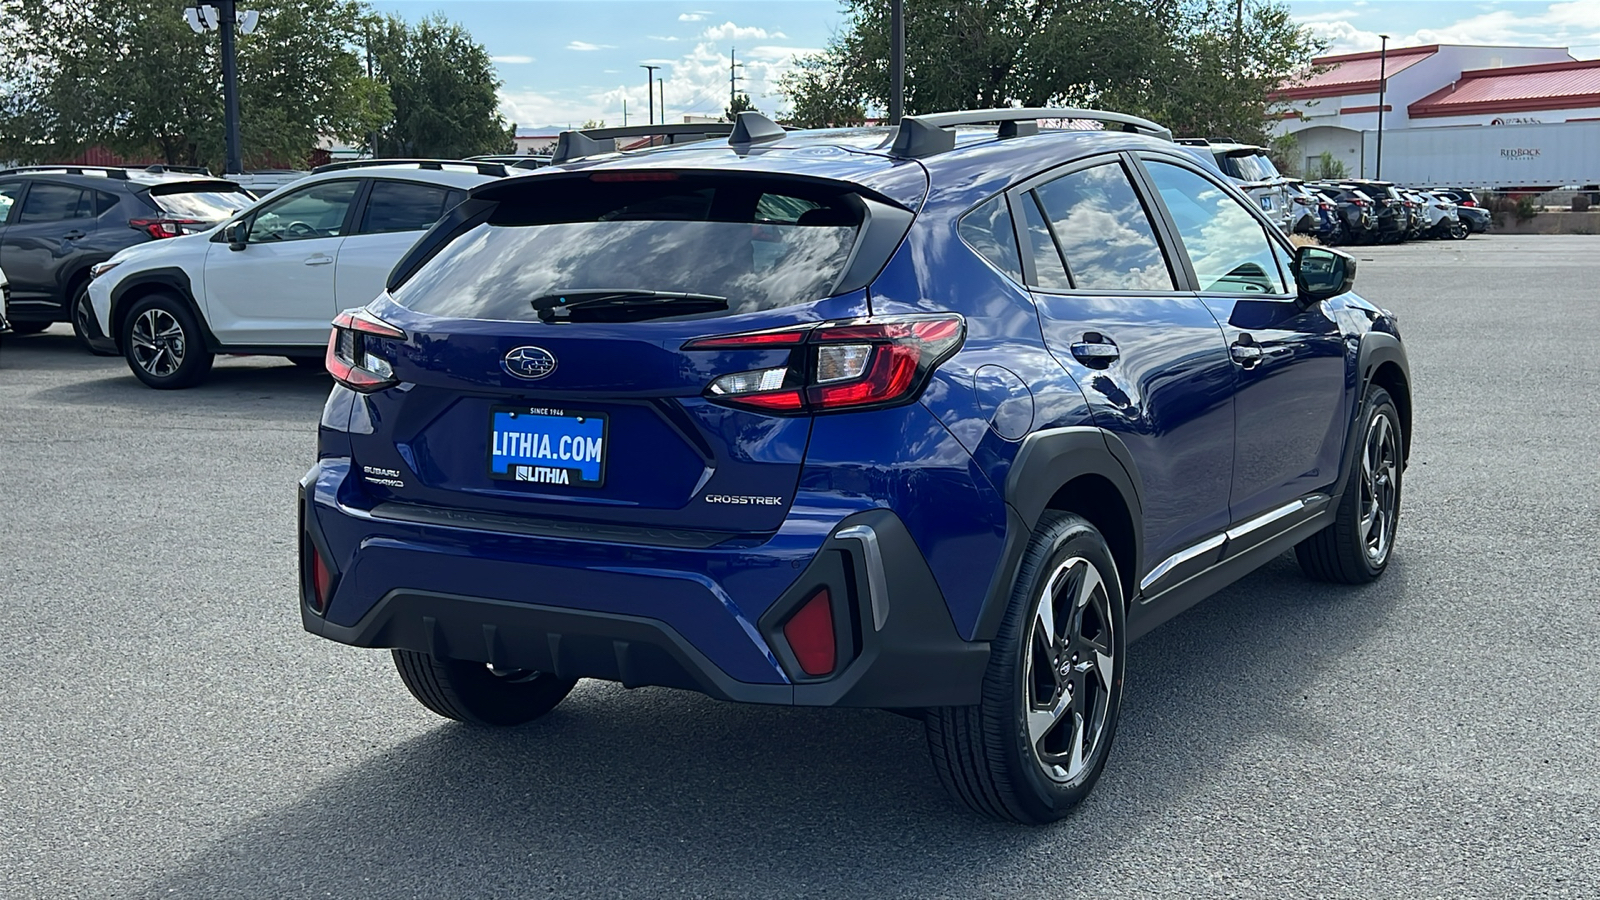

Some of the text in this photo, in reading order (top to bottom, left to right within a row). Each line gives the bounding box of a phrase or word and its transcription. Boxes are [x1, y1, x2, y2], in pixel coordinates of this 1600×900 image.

[530, 407, 564, 416] SINCE 1946
[492, 431, 602, 463] LITHIA.COM
[363, 466, 400, 477] SUBARU
[527, 466, 569, 485] LITHIA
[705, 494, 782, 505] CROSSTREK
